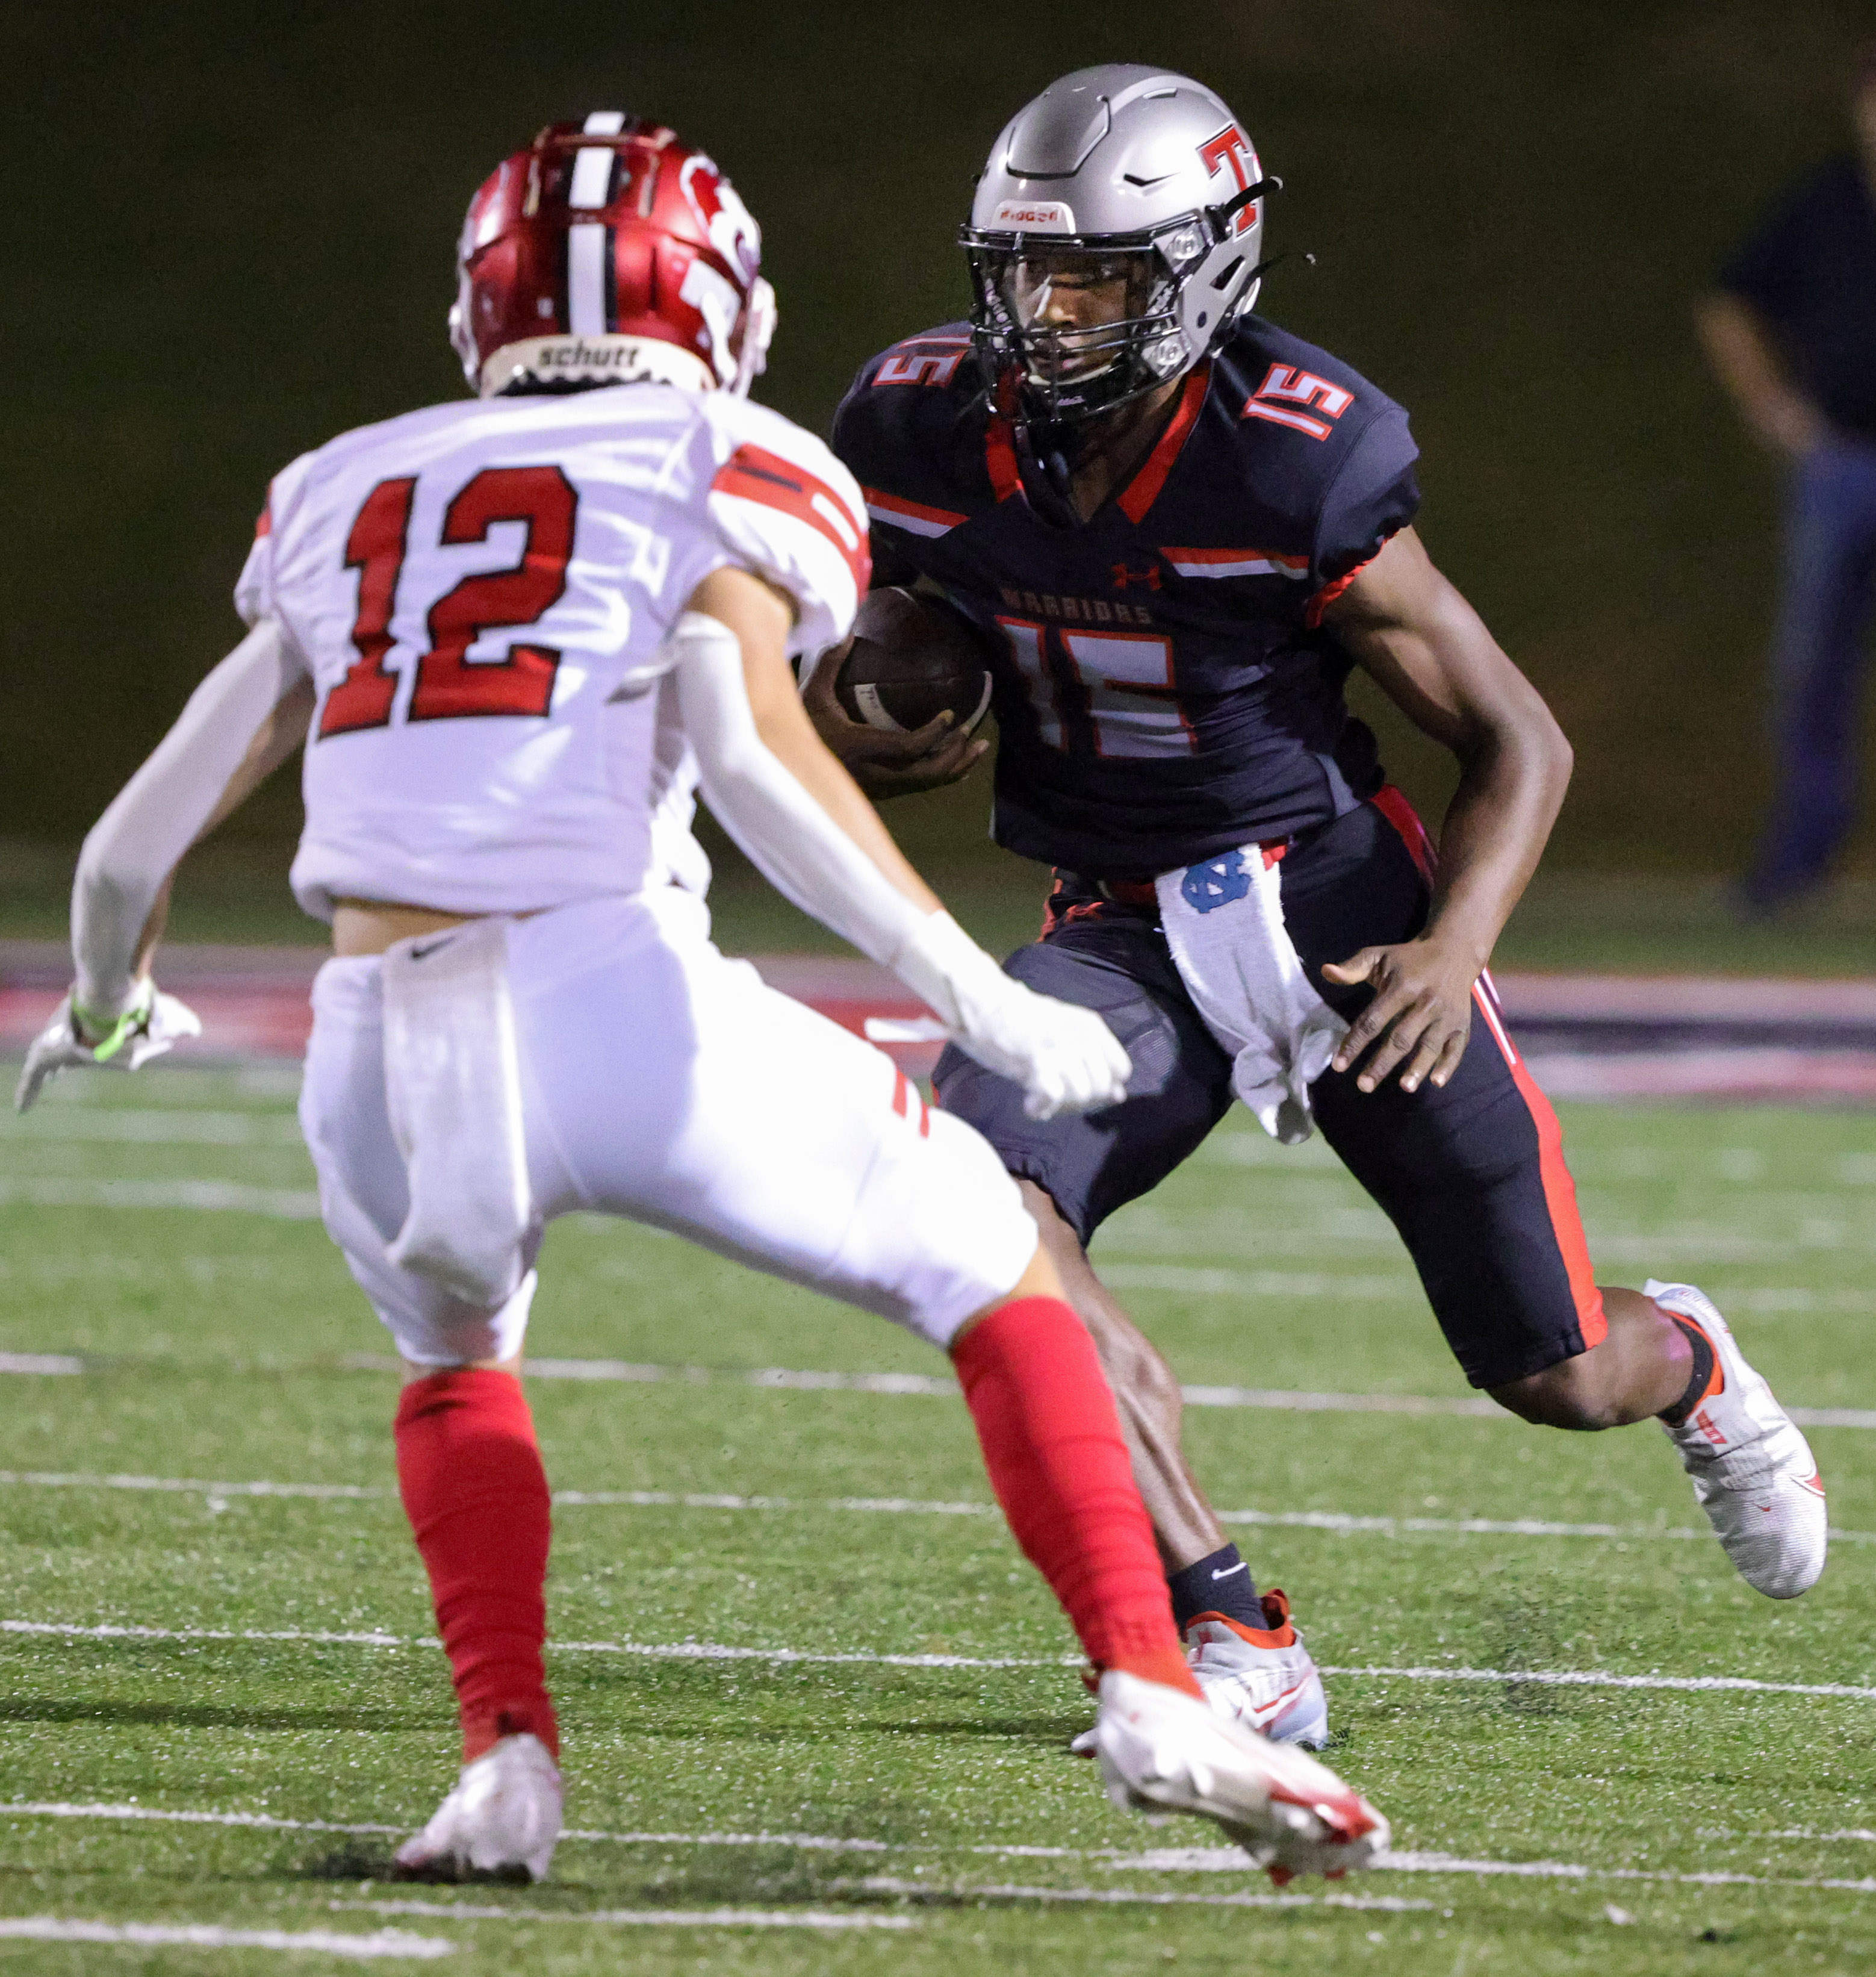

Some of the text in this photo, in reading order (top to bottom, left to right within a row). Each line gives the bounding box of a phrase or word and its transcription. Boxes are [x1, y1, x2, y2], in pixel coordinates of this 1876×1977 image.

[871, 333, 971, 387] 15
[1240, 362, 1355, 441] 15
[317, 465, 578, 742] 12
[1000, 588, 1152, 624] WARRIORS
[995, 614, 1198, 759] 15
